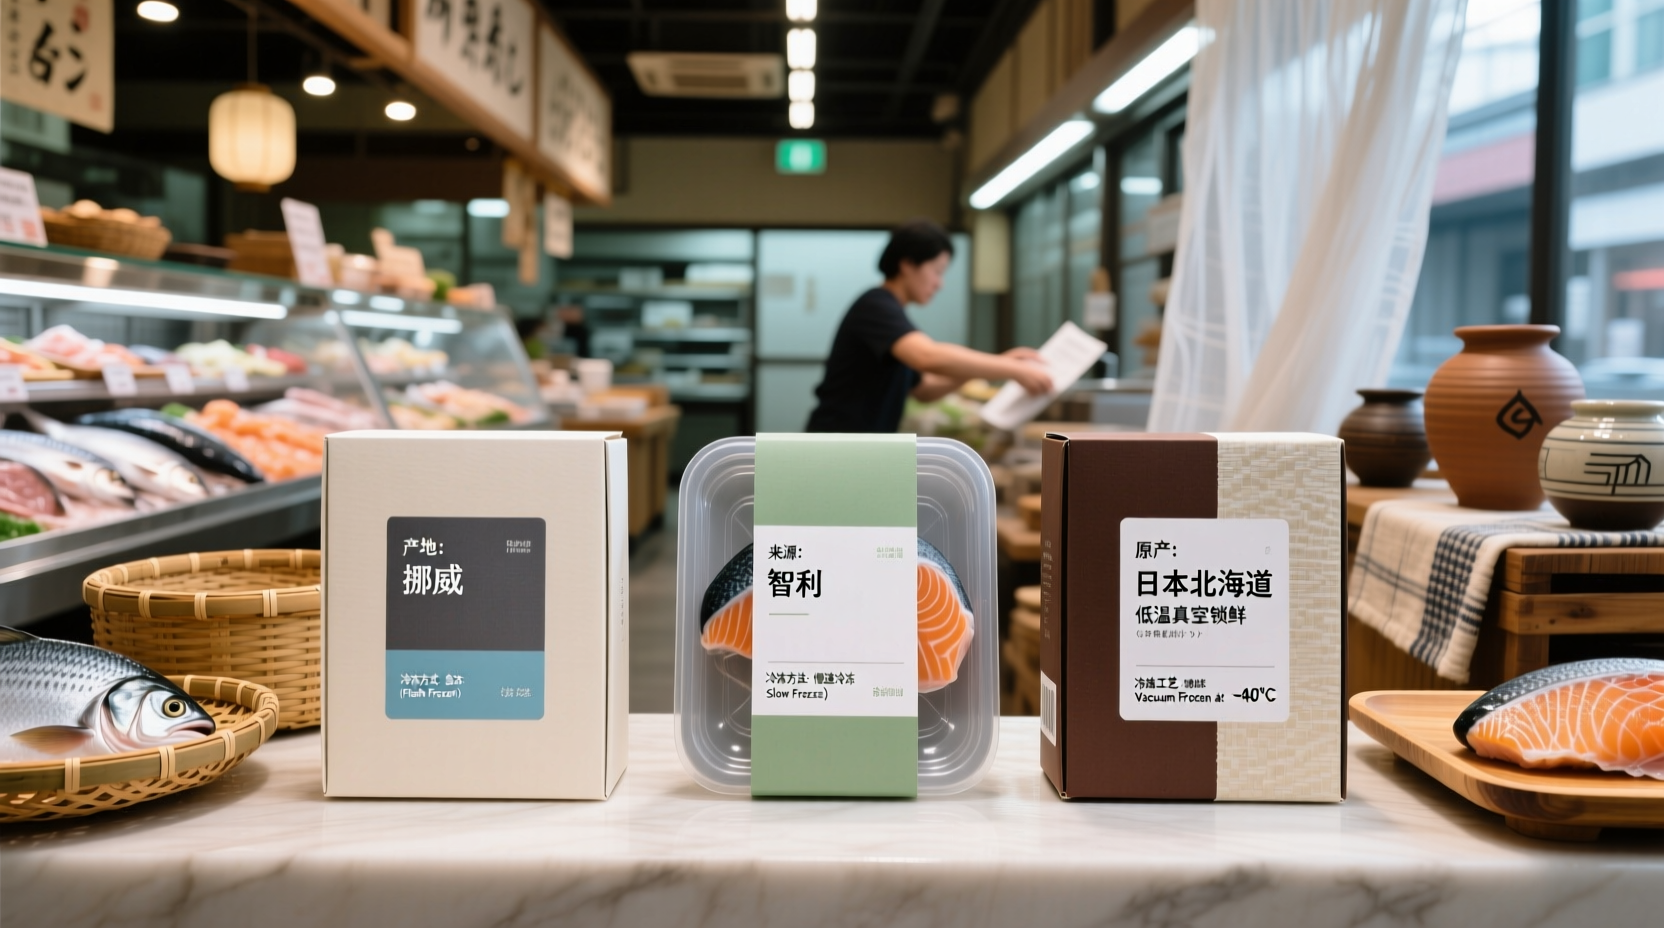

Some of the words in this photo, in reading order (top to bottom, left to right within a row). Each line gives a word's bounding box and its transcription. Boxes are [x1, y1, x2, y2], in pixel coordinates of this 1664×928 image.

[402, 563, 464, 596] 挪威
[767, 567, 823, 599] 智利
[1137, 568, 1273, 599] 日本北海道
[1135, 604, 1247, 626] 低温真空锁鲜
[766, 687, 790, 699] Slow
